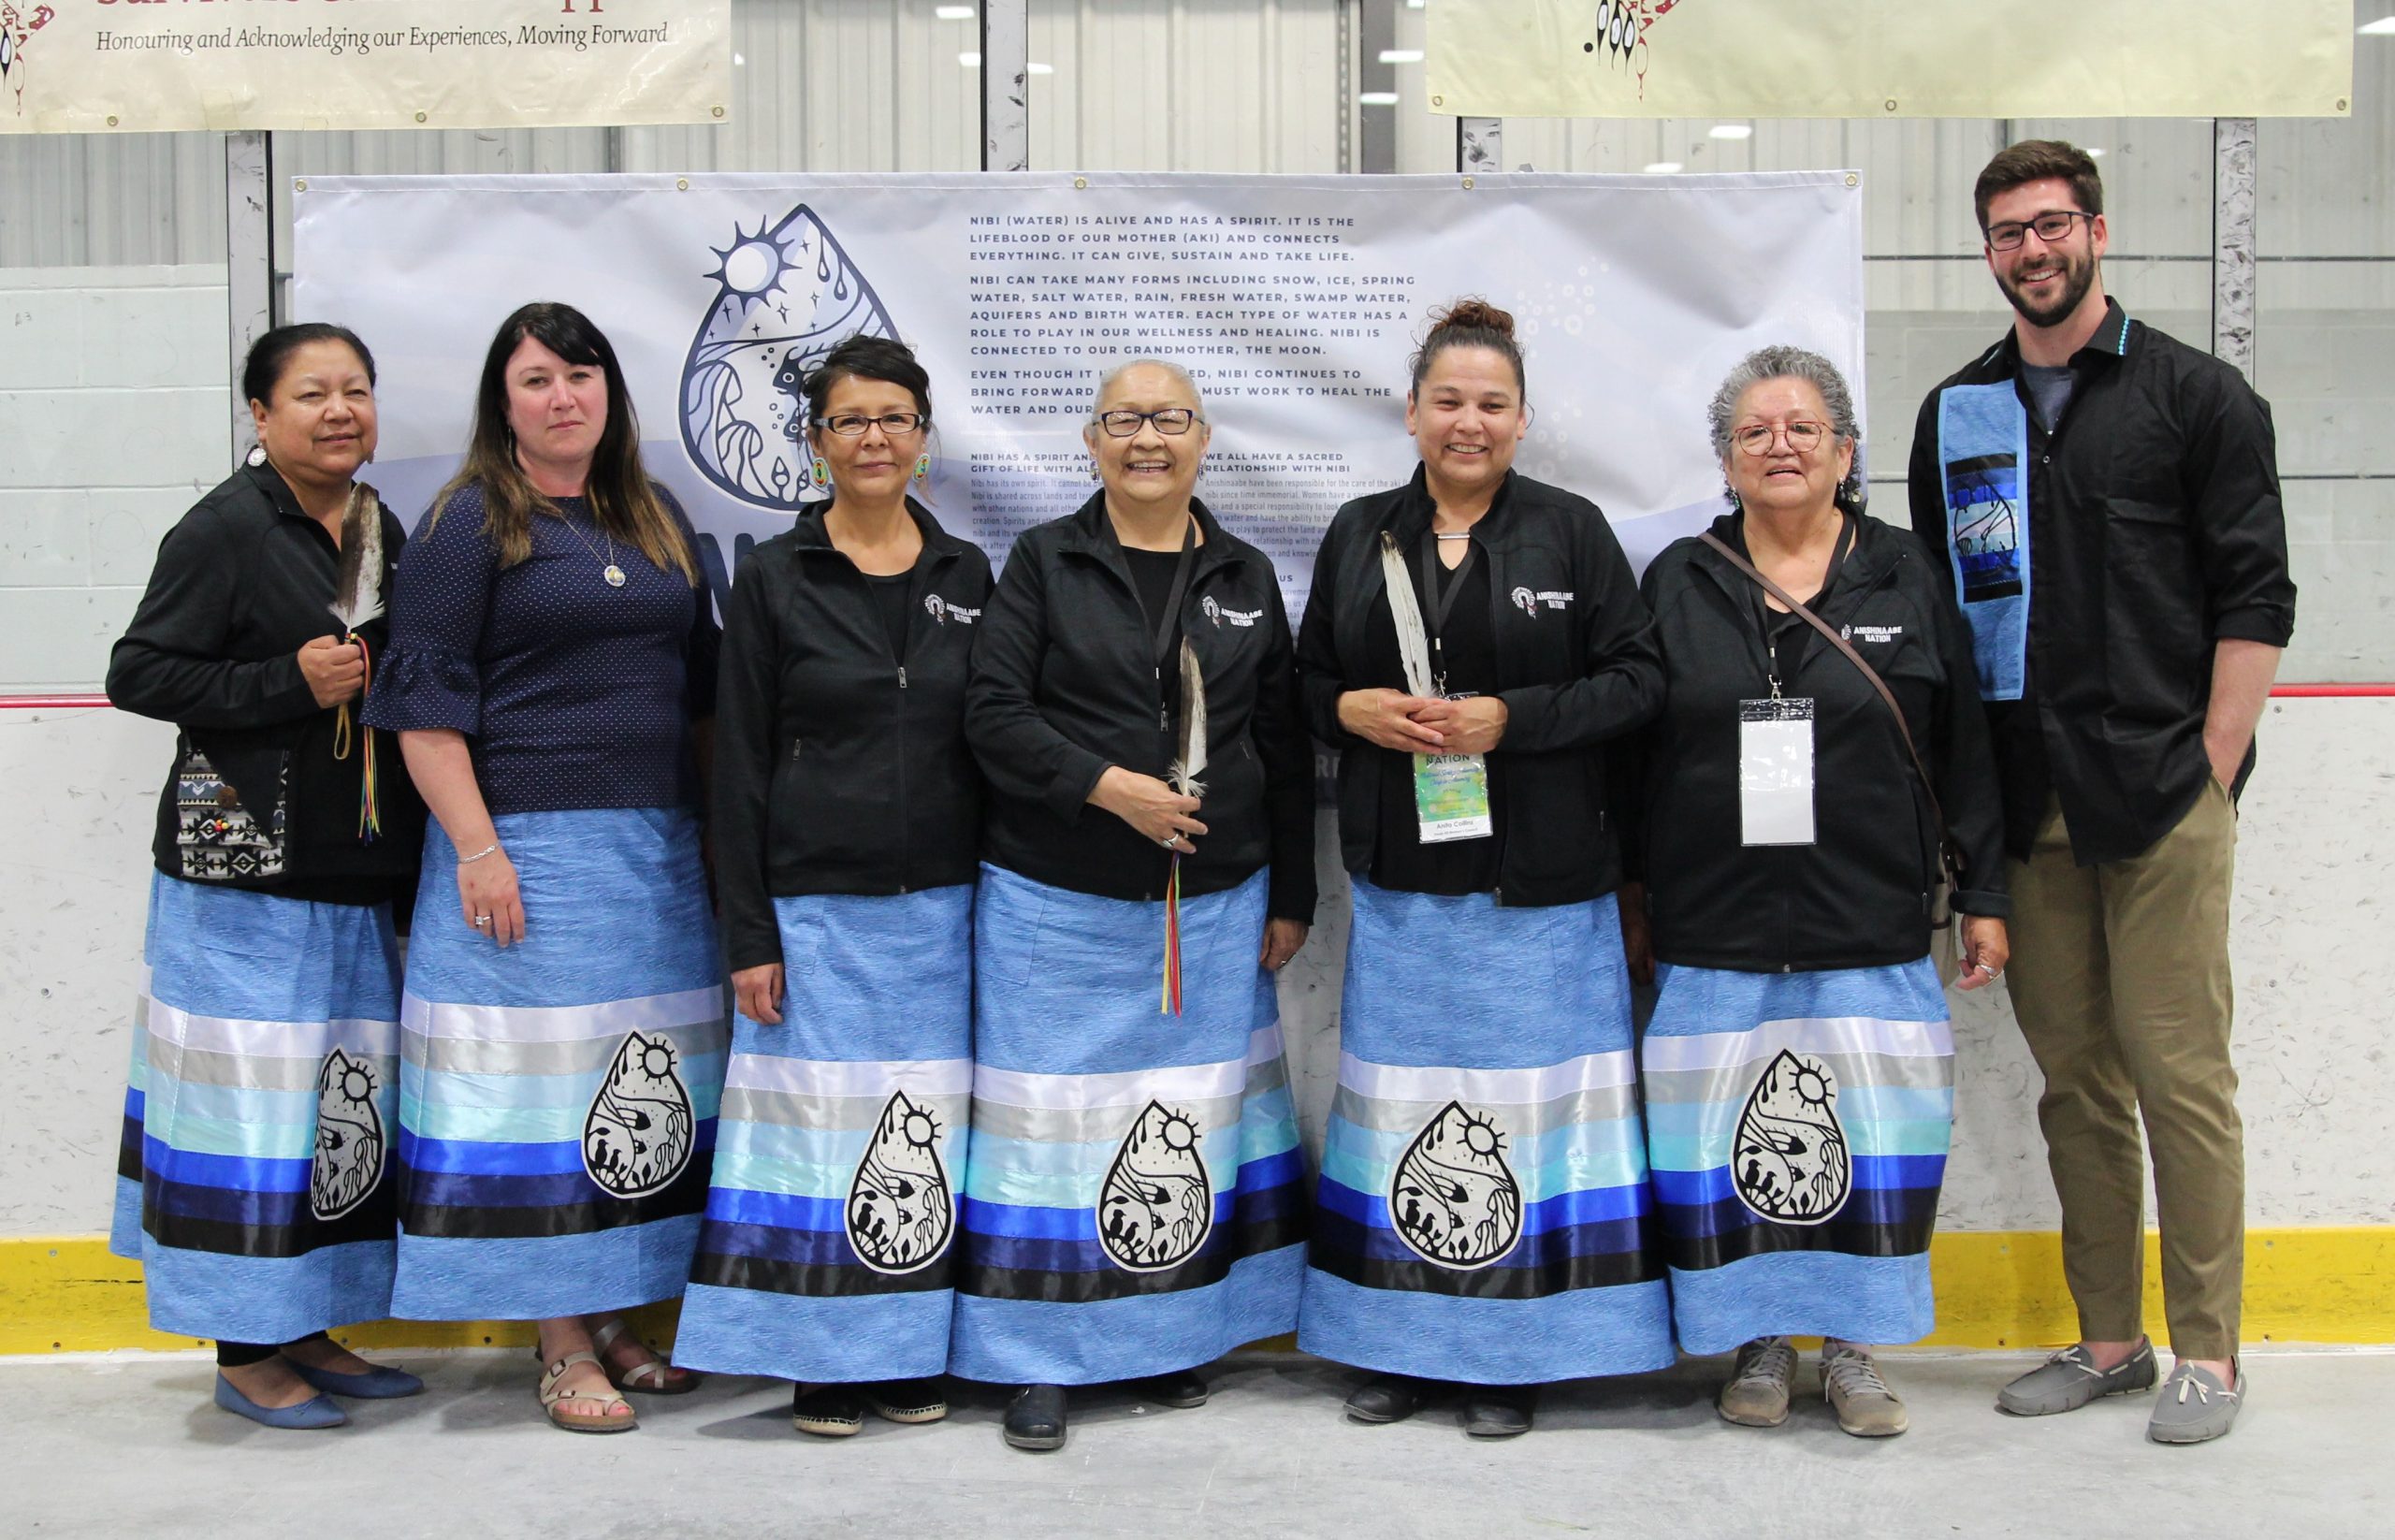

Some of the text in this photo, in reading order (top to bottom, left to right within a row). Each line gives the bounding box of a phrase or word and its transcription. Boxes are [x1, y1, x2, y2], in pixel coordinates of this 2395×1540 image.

[96, 22, 668, 55] Honouring and Acknowledging our Experiences, Moving Forward
[970, 216, 1000, 225] NIBI
[1007, 215, 1068, 226] (WATER)
[1076, 216, 1089, 225] IS
[1095, 216, 1137, 225] ALIVE
[1143, 216, 1173, 225] AND
[1180, 216, 1208, 225] HAS
[1230, 217, 1282, 225] SPIRIT.
[1288, 217, 1301, 225] IT
[1308, 217, 1321, 226] IS
[1327, 217, 1354, 226] THE
[970, 232, 1340, 243] LIFEBLOOD OF OUR MOTHER (AKI) AND CONNECTS
[969, 251, 1354, 262] EVERYTHING. IT CAN GIVE, SUSTAIN AND TAKE LIFE.
[970, 275, 1415, 286] NIBI CAN TAKE MANY FORMS INCLUDING SNOW, ICE, SPRING
[970, 293, 1411, 304] WATER, SALT WATER, RAIN, FRESH WATER, SWAMP WATER,
[970, 311, 1407, 322] AQUIFERS AND BIRTH WATER. EACH TYPE OF WATER HAS A
[970, 327, 1380, 338] ROLE TO PLAY IN OUR WELLNESS AND HEALING. NIBI IS
[970, 345, 1327, 356] CONNECTED TO OUR GRANDMOTHER, THE MOON.
[971, 370, 1007, 379] EVEN
[1013, 370, 1072, 379] THOUGH
[1080, 370, 1093, 378] IT
[1218, 370, 1248, 378] NIBI
[1255, 370, 1336, 379] CONTINUES
[1343, 370, 1361, 379] TO
[971, 387, 1390, 397] BRING FORWARD MUST WORK TO HEAL THE
[971, 405, 1094, 414] WATER AND OUR
[1206, 453, 1223, 461] WE
[971, 464, 995, 472] GIFT
[1206, 464, 1287, 472] RELATIONSHIP
[1249, 479, 1265, 487] have
[1267, 479, 1284, 487] been
[1853, 626, 1903, 634] ANISHINAABE
[1865, 634, 1891, 643] NATION
